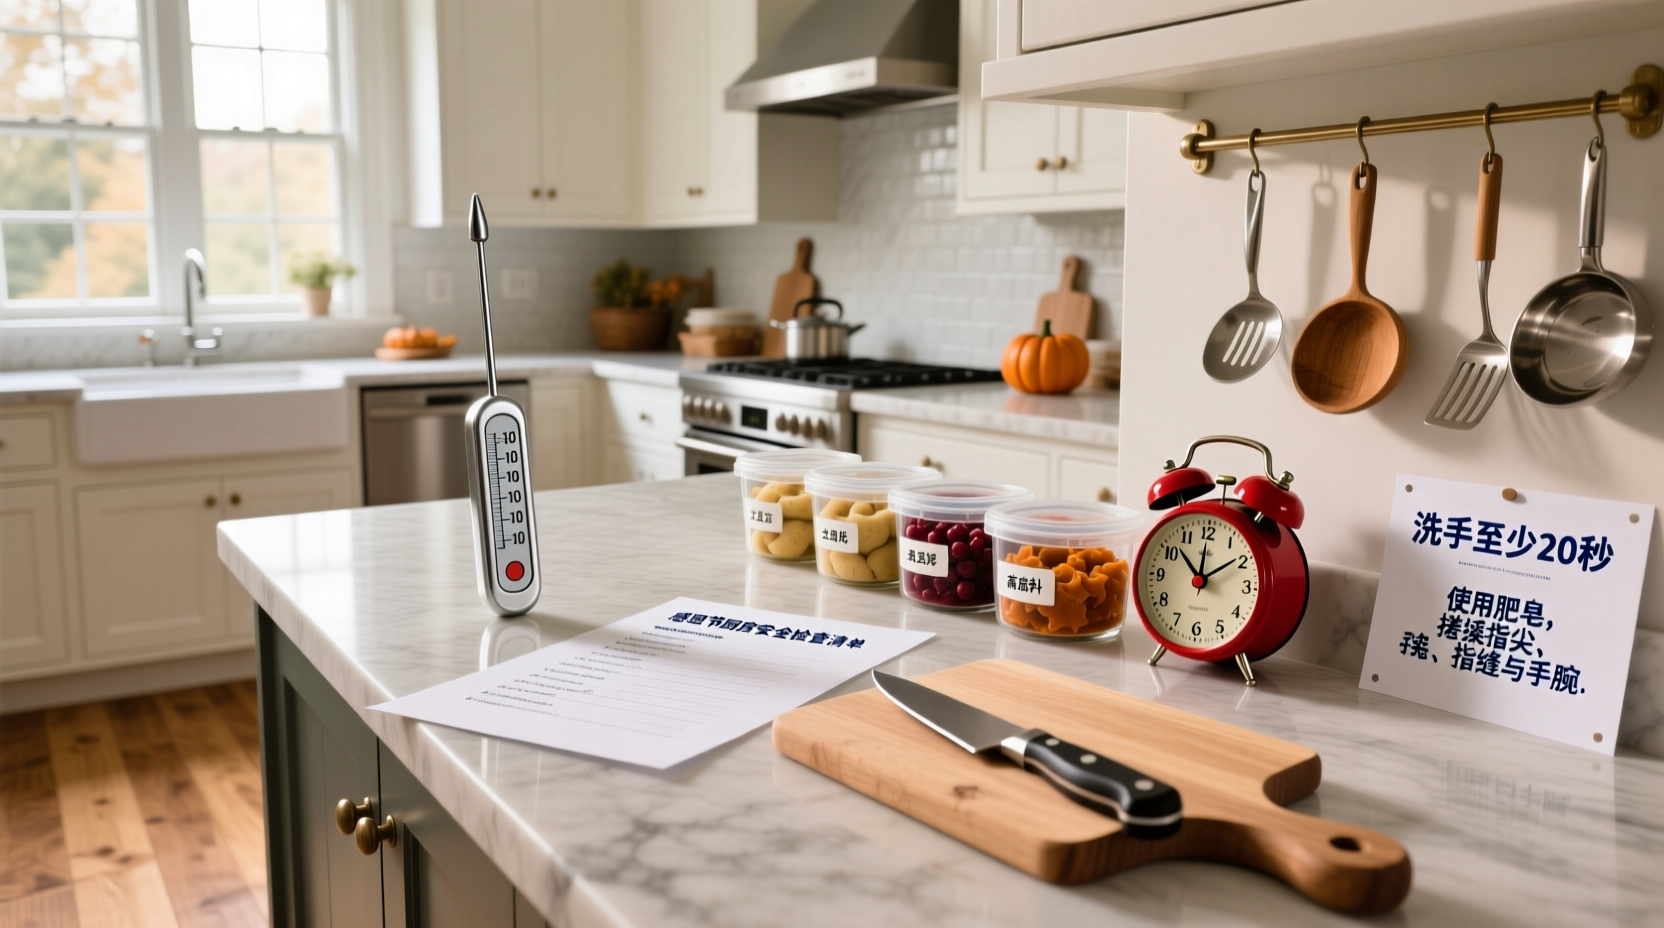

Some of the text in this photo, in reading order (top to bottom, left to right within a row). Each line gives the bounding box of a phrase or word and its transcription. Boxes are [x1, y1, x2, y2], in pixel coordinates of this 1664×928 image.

[502, 431, 516, 445] 10
[505, 450, 518, 464] 10
[506, 470, 519, 483] 10
[508, 490, 521, 503] 10
[510, 510, 523, 524] 10
[512, 531, 525, 545] 10
[1180, 530, 1192, 544] 11
[1201, 526, 1216, 541] 12
[1228, 537, 1232, 549] 1
[1412, 512, 1613, 572] 洗手至少20秒
[1164, 545, 1178, 561] 10
[1238, 555, 1248, 569] 2
[1156, 567, 1165, 582] 9
[1242, 580, 1251, 594] 3
[1160, 591, 1168, 607] 8
[1231, 605, 1240, 618] 4
[1447, 586, 1554, 631] 使用肥皂，
[1173, 612, 1181, 626] 7
[1192, 622, 1201, 636] 6
[1215, 620, 1224, 634] 5
